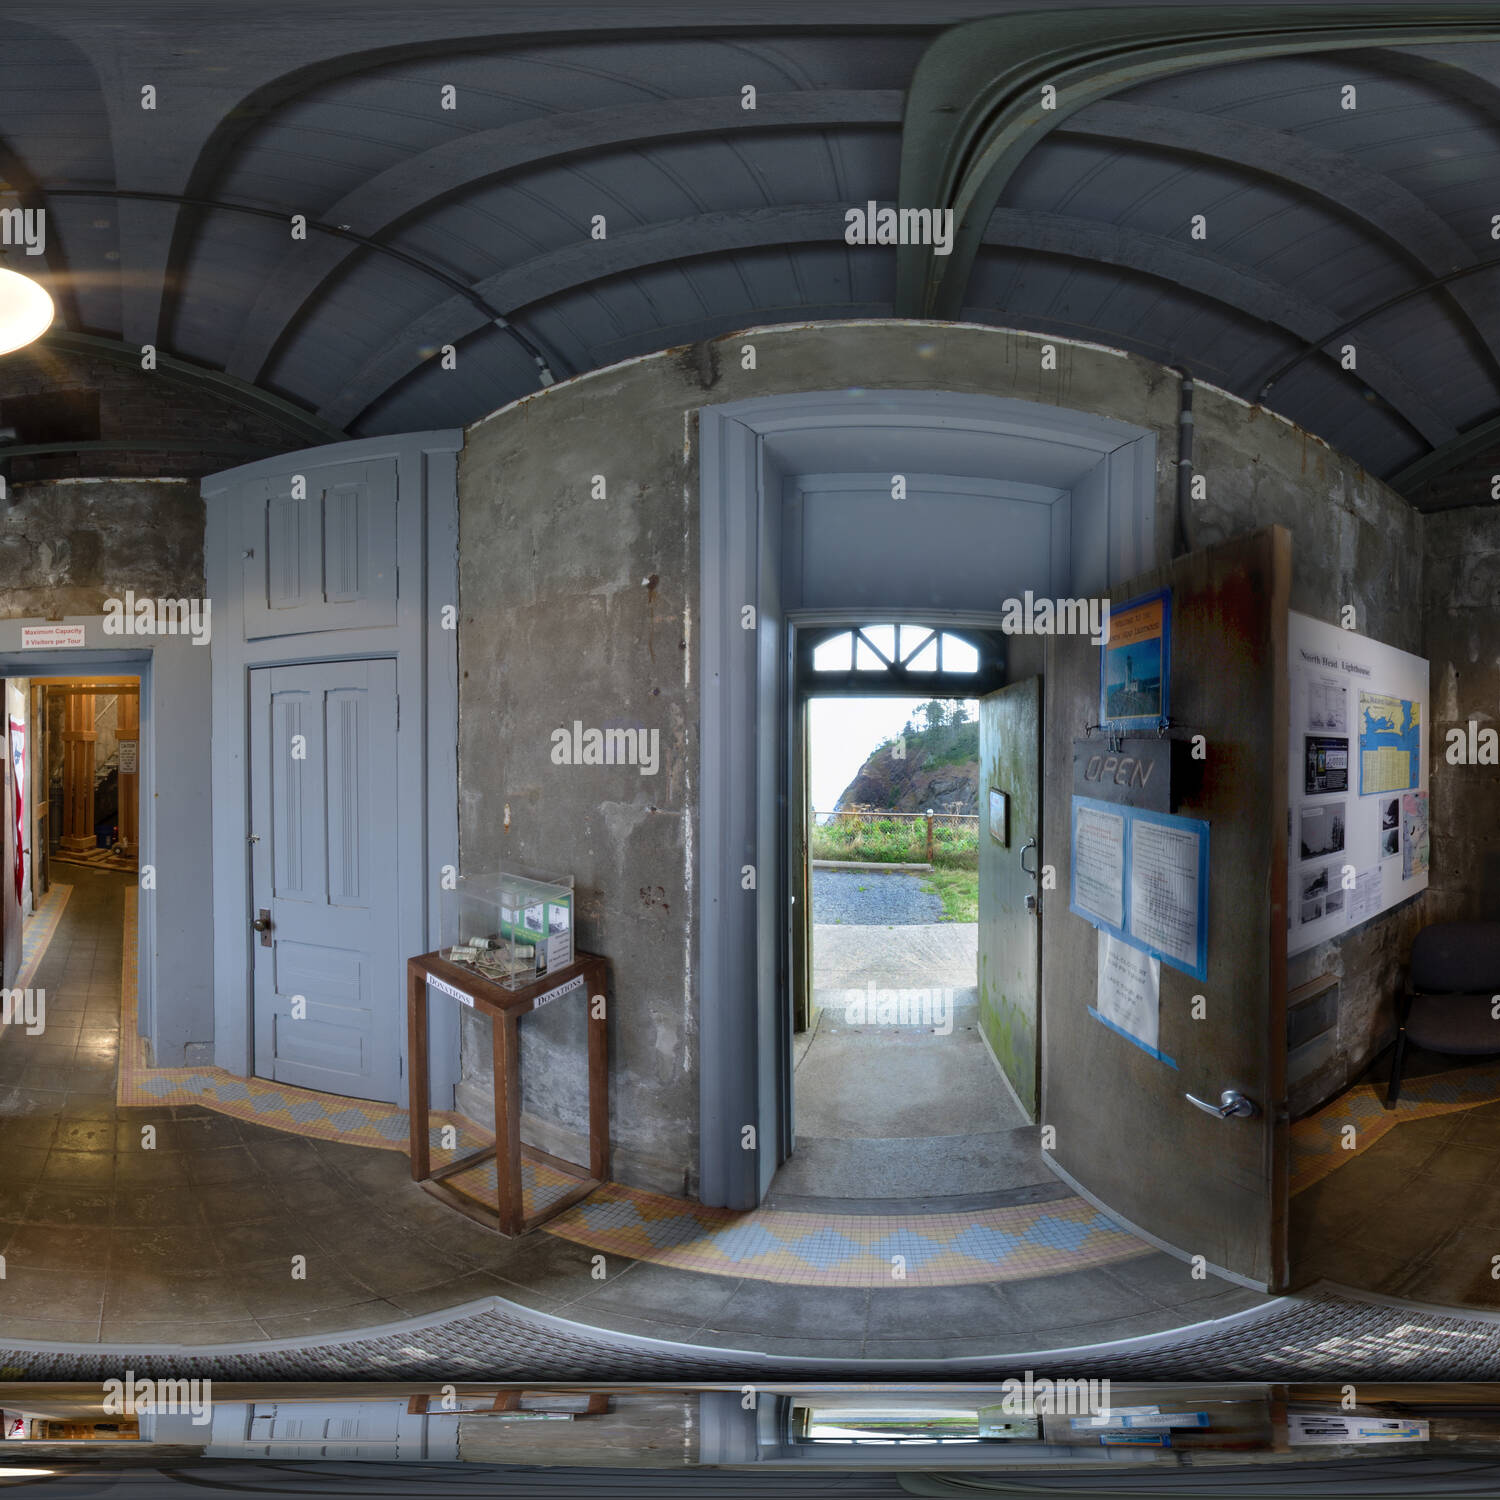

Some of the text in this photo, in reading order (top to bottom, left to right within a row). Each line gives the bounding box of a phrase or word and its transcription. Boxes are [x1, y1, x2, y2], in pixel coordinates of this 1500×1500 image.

[1300, 649, 1370, 676] North Head Lighthouse
[1084, 755, 1155, 788] OPEN
[429, 975, 472, 1005] DONATIONS
[538, 978, 581, 1006] DONATIONS
